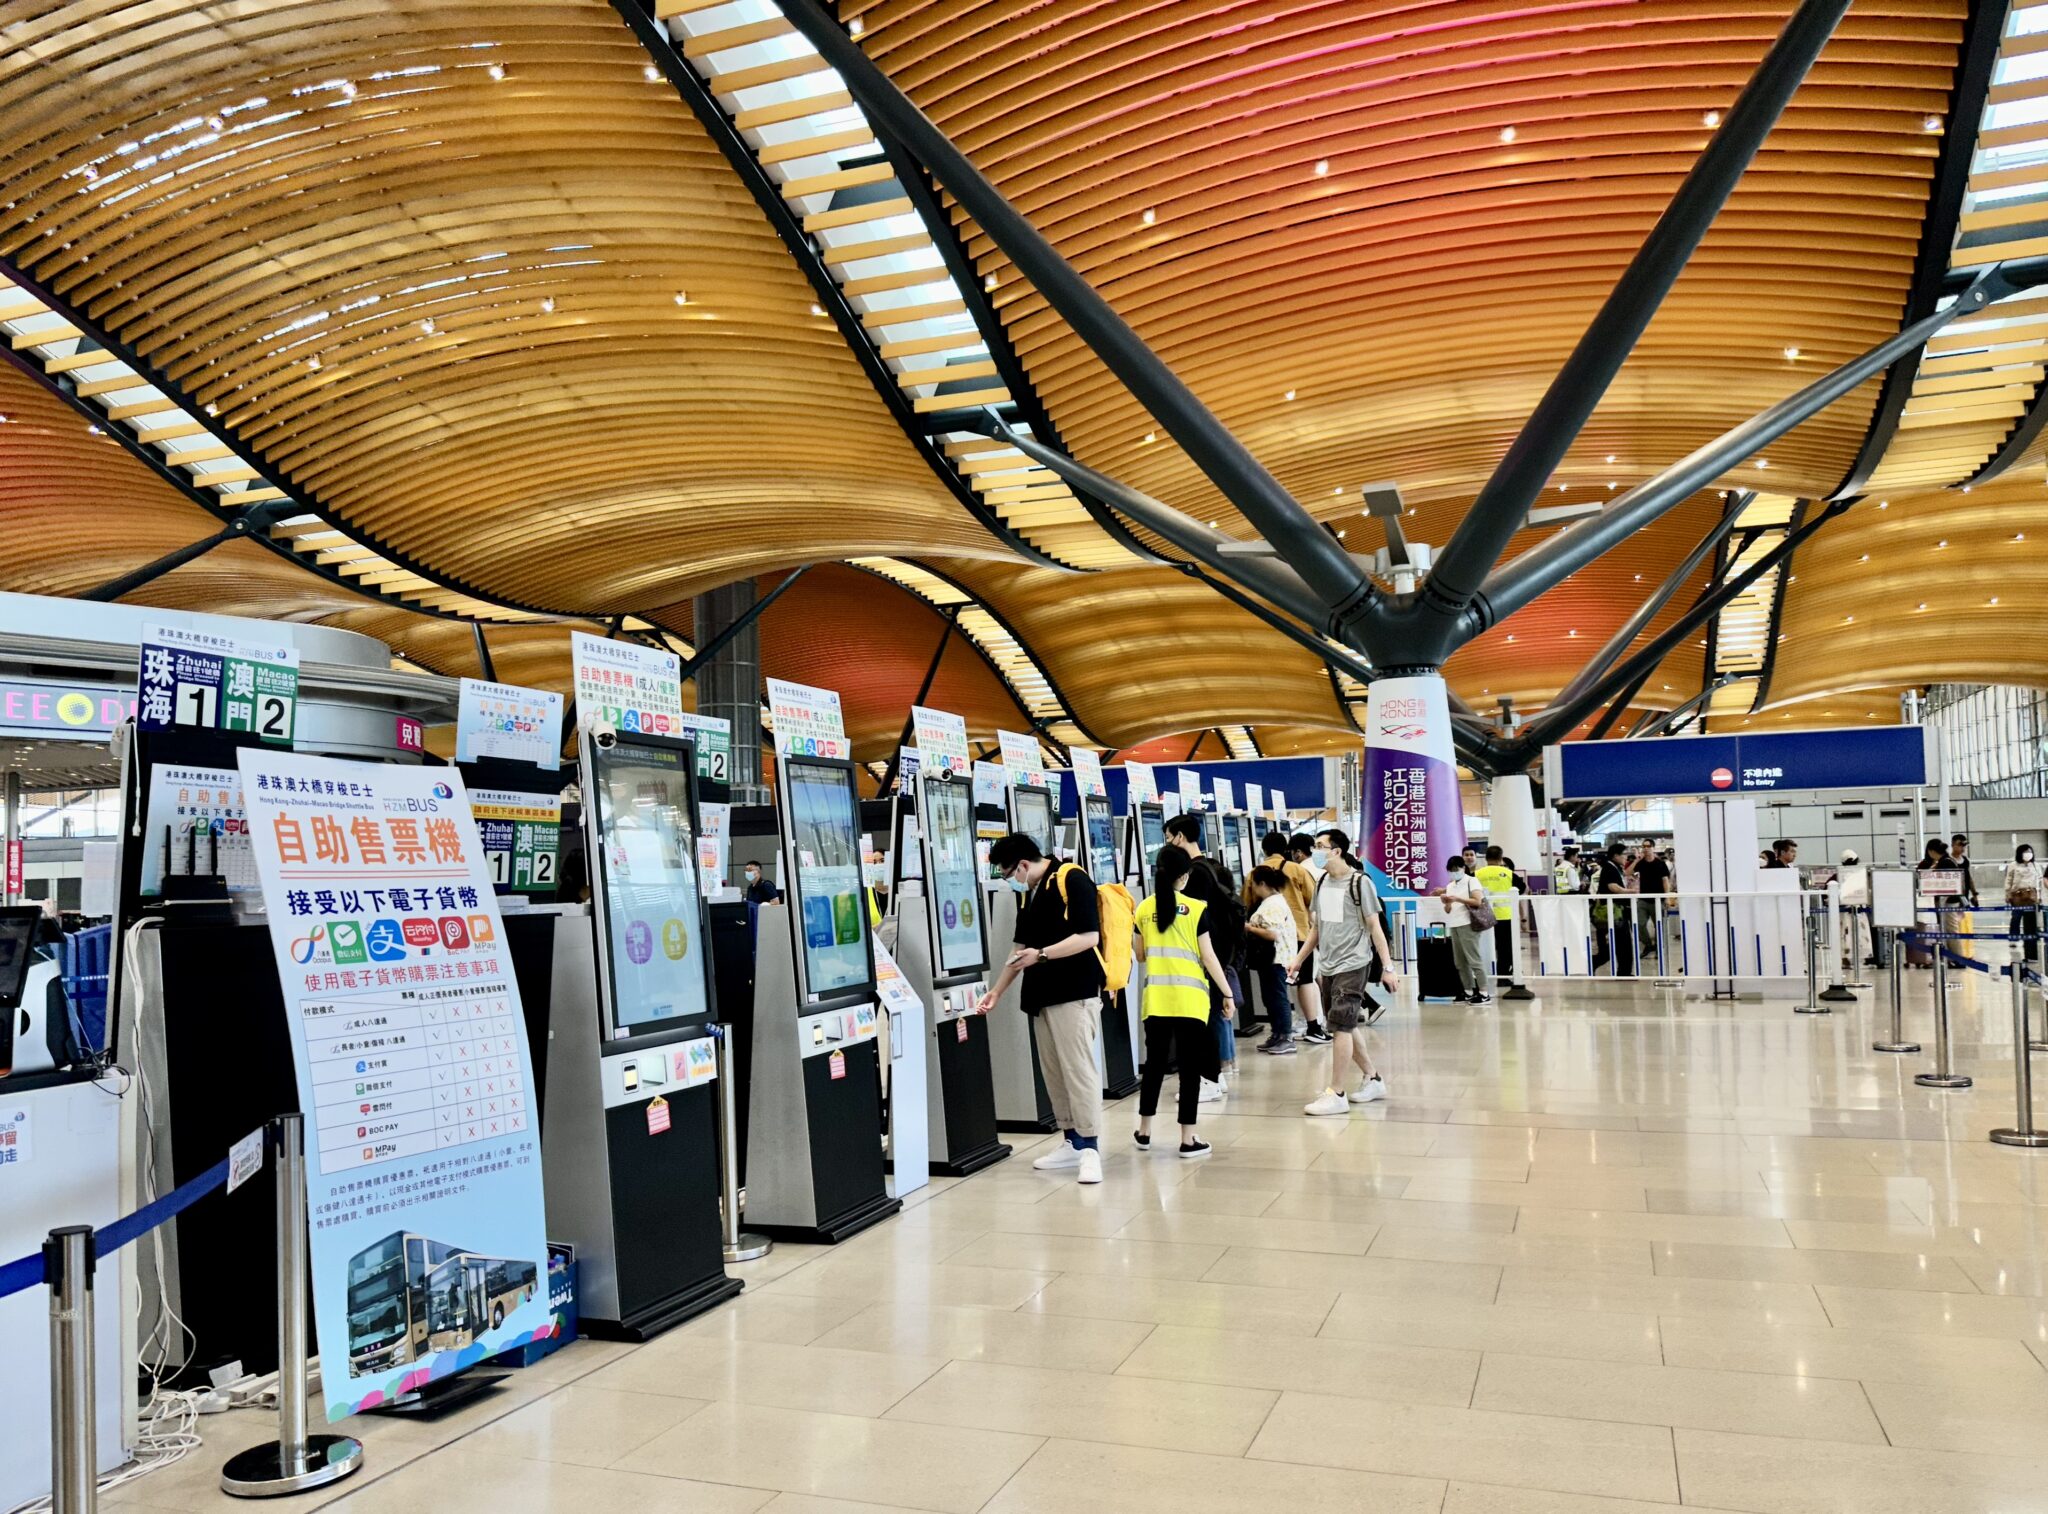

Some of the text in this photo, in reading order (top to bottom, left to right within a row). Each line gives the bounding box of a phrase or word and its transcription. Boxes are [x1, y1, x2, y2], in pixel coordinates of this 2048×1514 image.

[177, 654, 222, 670] Zhuhai
[257, 667, 295, 681] Macao
[141, 648, 175, 725] 珠海
[226, 661, 254, 732] 澳門
[189, 688, 205, 727] 1
[263, 698, 284, 735] 2
[1380, 698, 1417, 709] HONG
[1380, 709, 1417, 719] KONG
[714, 753, 724, 778] 2
[256, 774, 374, 798] 港珠澳大橋穿梭巴士
[1755, 779, 1776, 787] Entry
[259, 795, 275, 804] Hong
[329, 801, 346, 810] Bridge
[346, 802, 364, 810] Shuttle
[273, 811, 466, 866] 自助售票機
[486, 822, 514, 833] Zhuhai
[533, 825, 558, 835] Macao
[1383, 769, 1395, 890] ASIA'S WORLD CITY
[1392, 768, 1410, 890] HONG KONG
[1408, 767, 1429, 890] 香港亞洲國際都會
[493, 853, 503, 882] 1
[515, 823, 534, 886] 澳門
[537, 853, 552, 881] 2
[287, 886, 479, 916] 接受以下電子貨幣
[474, 942, 496, 950] MPay
[305, 959, 500, 992] 使用電子貨幣購票注意事項
[384, 1122, 399, 1132] PAY
[375, 1144, 397, 1154] MPay
